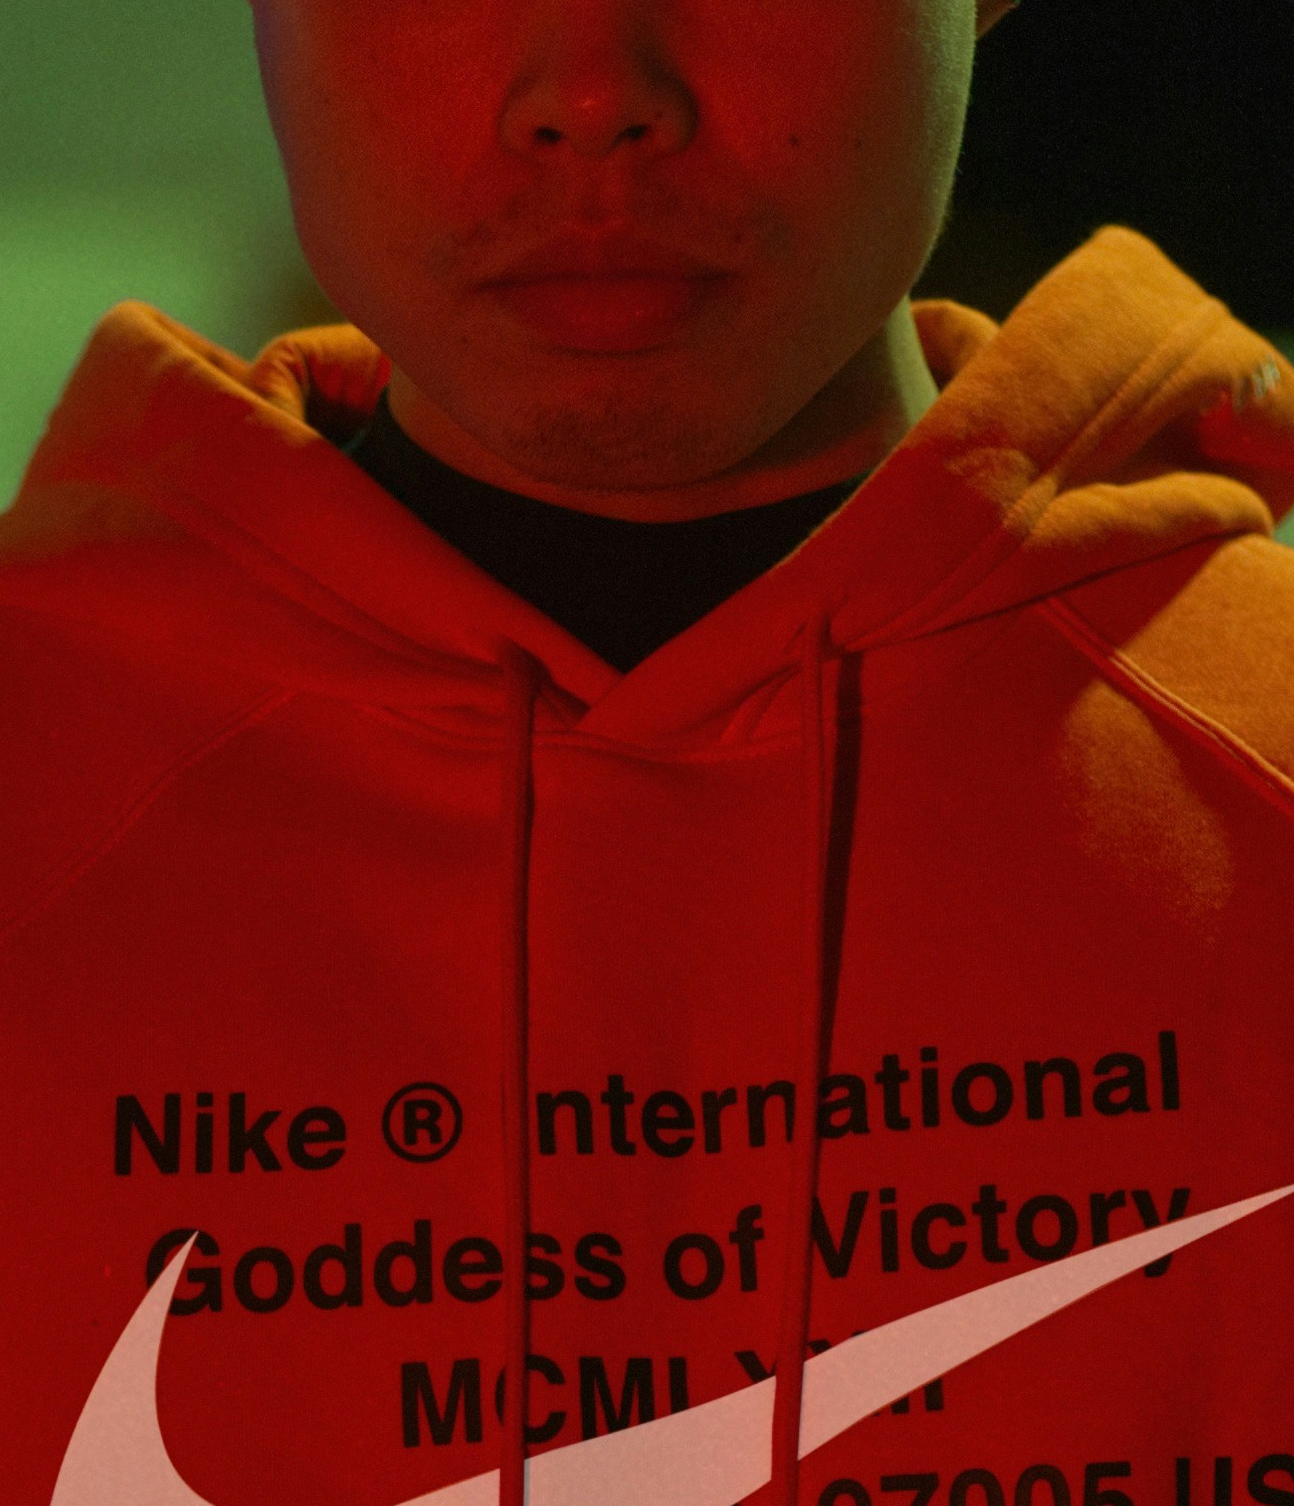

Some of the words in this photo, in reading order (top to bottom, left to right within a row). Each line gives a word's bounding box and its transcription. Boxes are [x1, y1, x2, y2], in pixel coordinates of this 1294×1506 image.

[113, 1092, 347, 1176] Nike
[536, 1030, 1181, 1158] nternational
[146, 1220, 626, 1316] Goddess
[663, 1204, 764, 1300] of
[811, 1184, 1190, 1278] Victory
